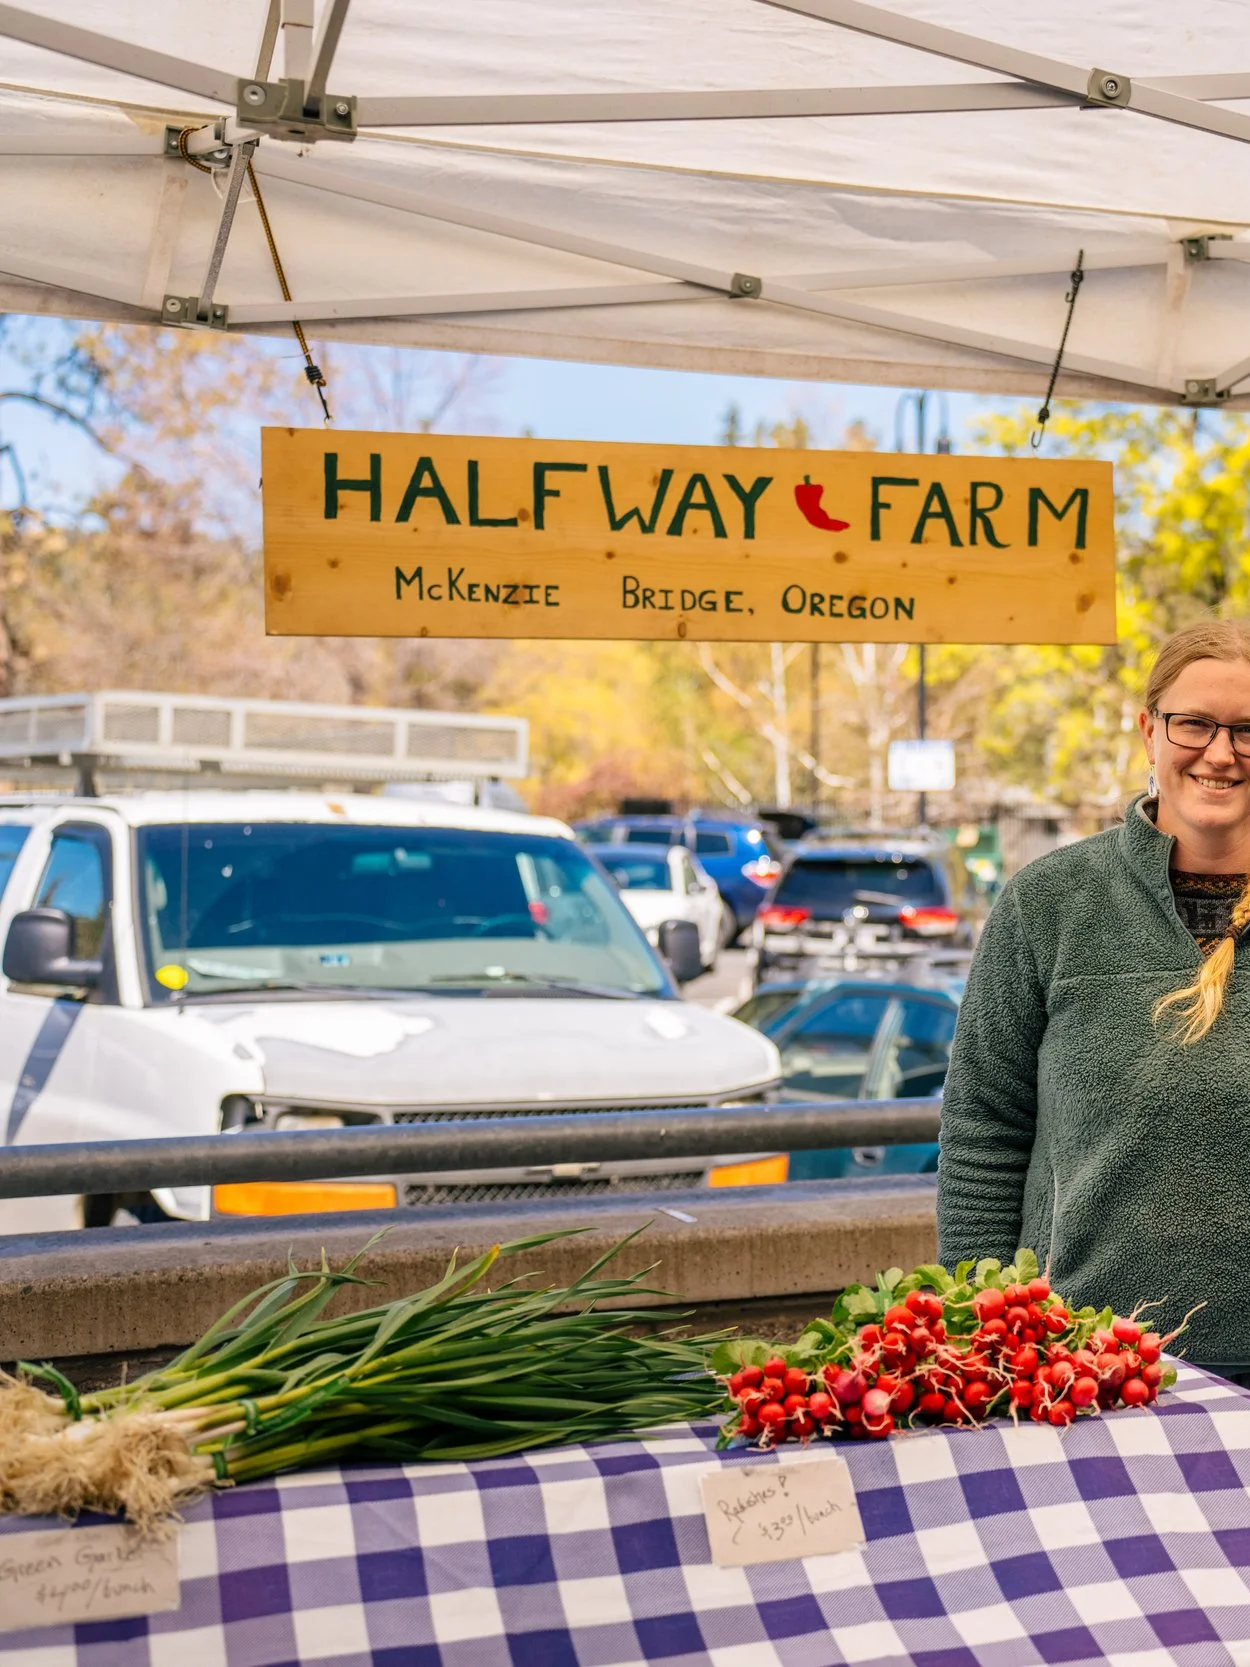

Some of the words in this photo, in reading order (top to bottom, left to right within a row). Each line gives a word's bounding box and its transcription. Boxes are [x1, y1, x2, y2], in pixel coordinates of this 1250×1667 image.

[324, 452, 774, 540] HALFWAY
[870, 476, 1089, 549] FARM
[781, 585, 915, 620] OREGON
[0, 1556, 62, 1583] Green
